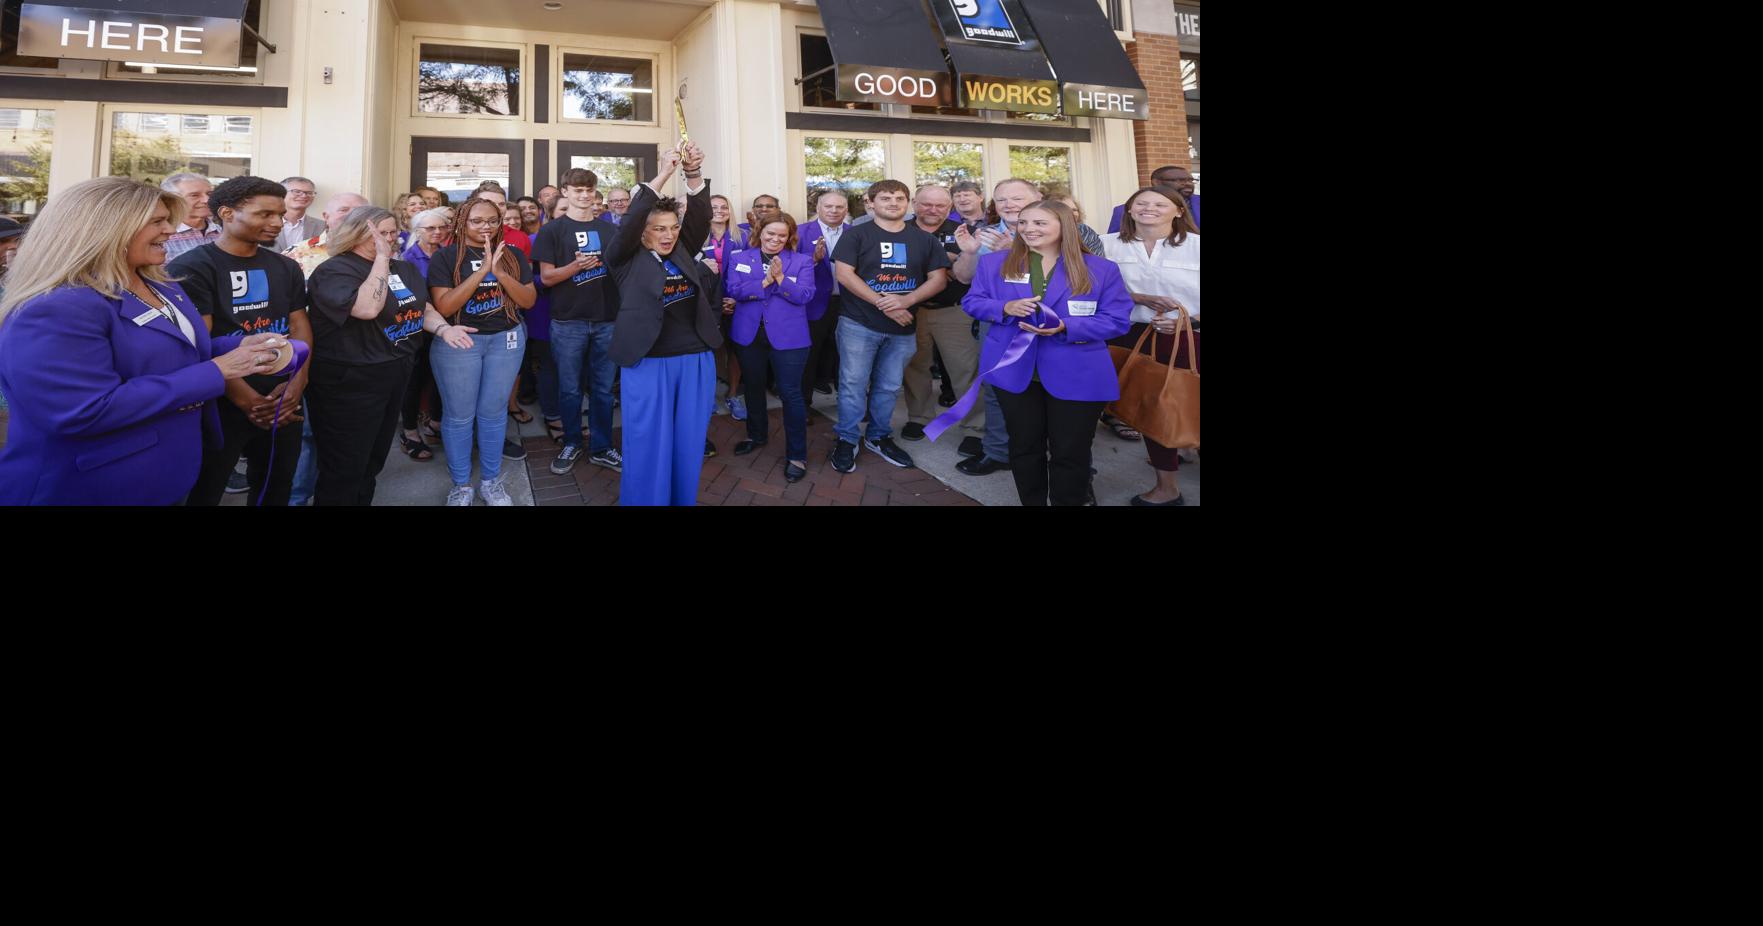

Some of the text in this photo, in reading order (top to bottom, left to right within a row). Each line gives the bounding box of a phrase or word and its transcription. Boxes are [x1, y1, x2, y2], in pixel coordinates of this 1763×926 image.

[60, 18, 204, 54] HERE
[965, 27, 1015, 38] goodwill
[854, 72, 1135, 112] GOOD WORKS HERE
[233, 301, 269, 314] goodwill
